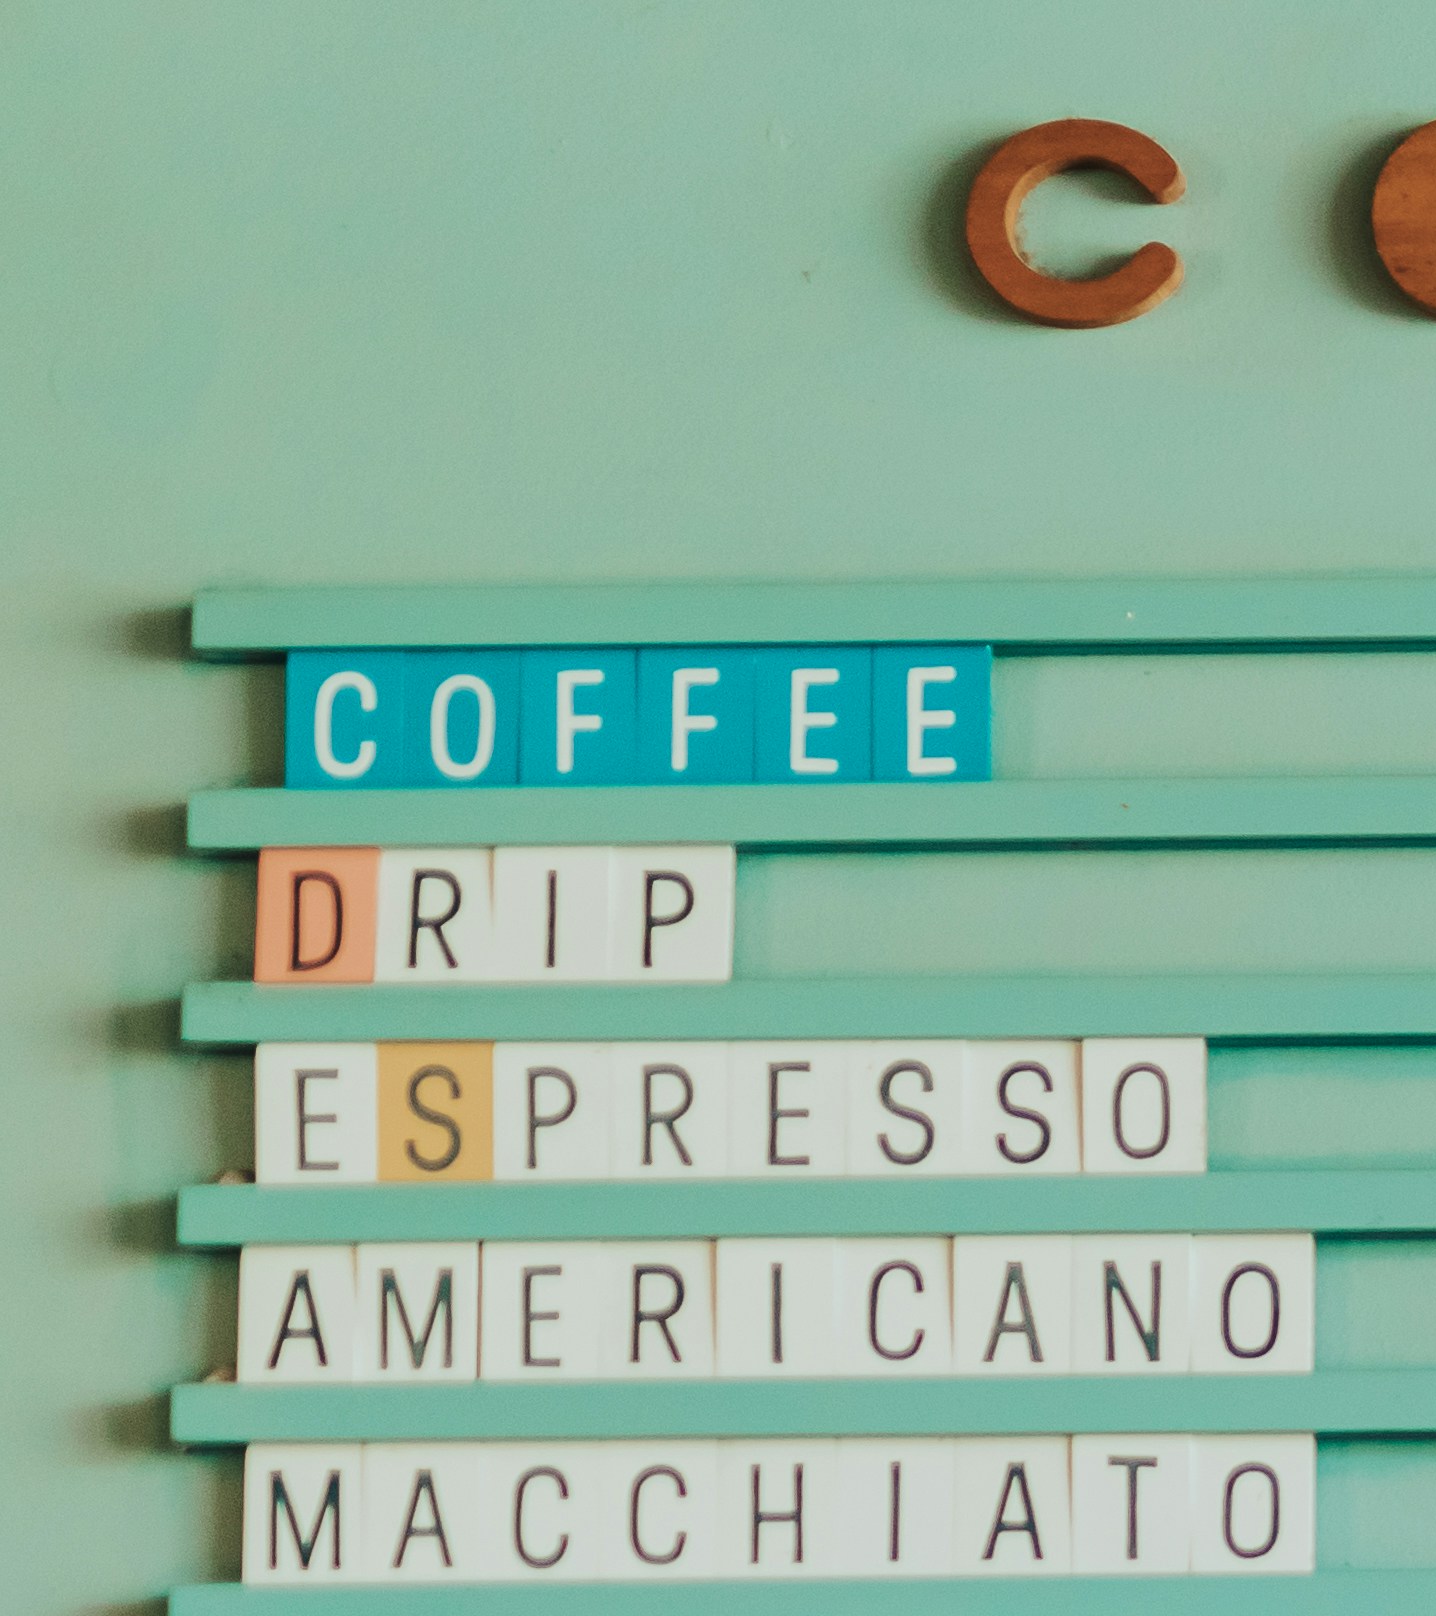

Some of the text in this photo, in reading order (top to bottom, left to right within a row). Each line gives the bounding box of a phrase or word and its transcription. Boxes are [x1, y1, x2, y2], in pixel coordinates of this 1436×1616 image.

[313, 665, 959, 779] COFFEE
[287, 869, 695, 971] DRIP
[293, 1060, 1172, 1173] ESPRESSO
[270, 1258, 1281, 1370] AMERICANO
[267, 1455, 1281, 1571] MACCHIATO
